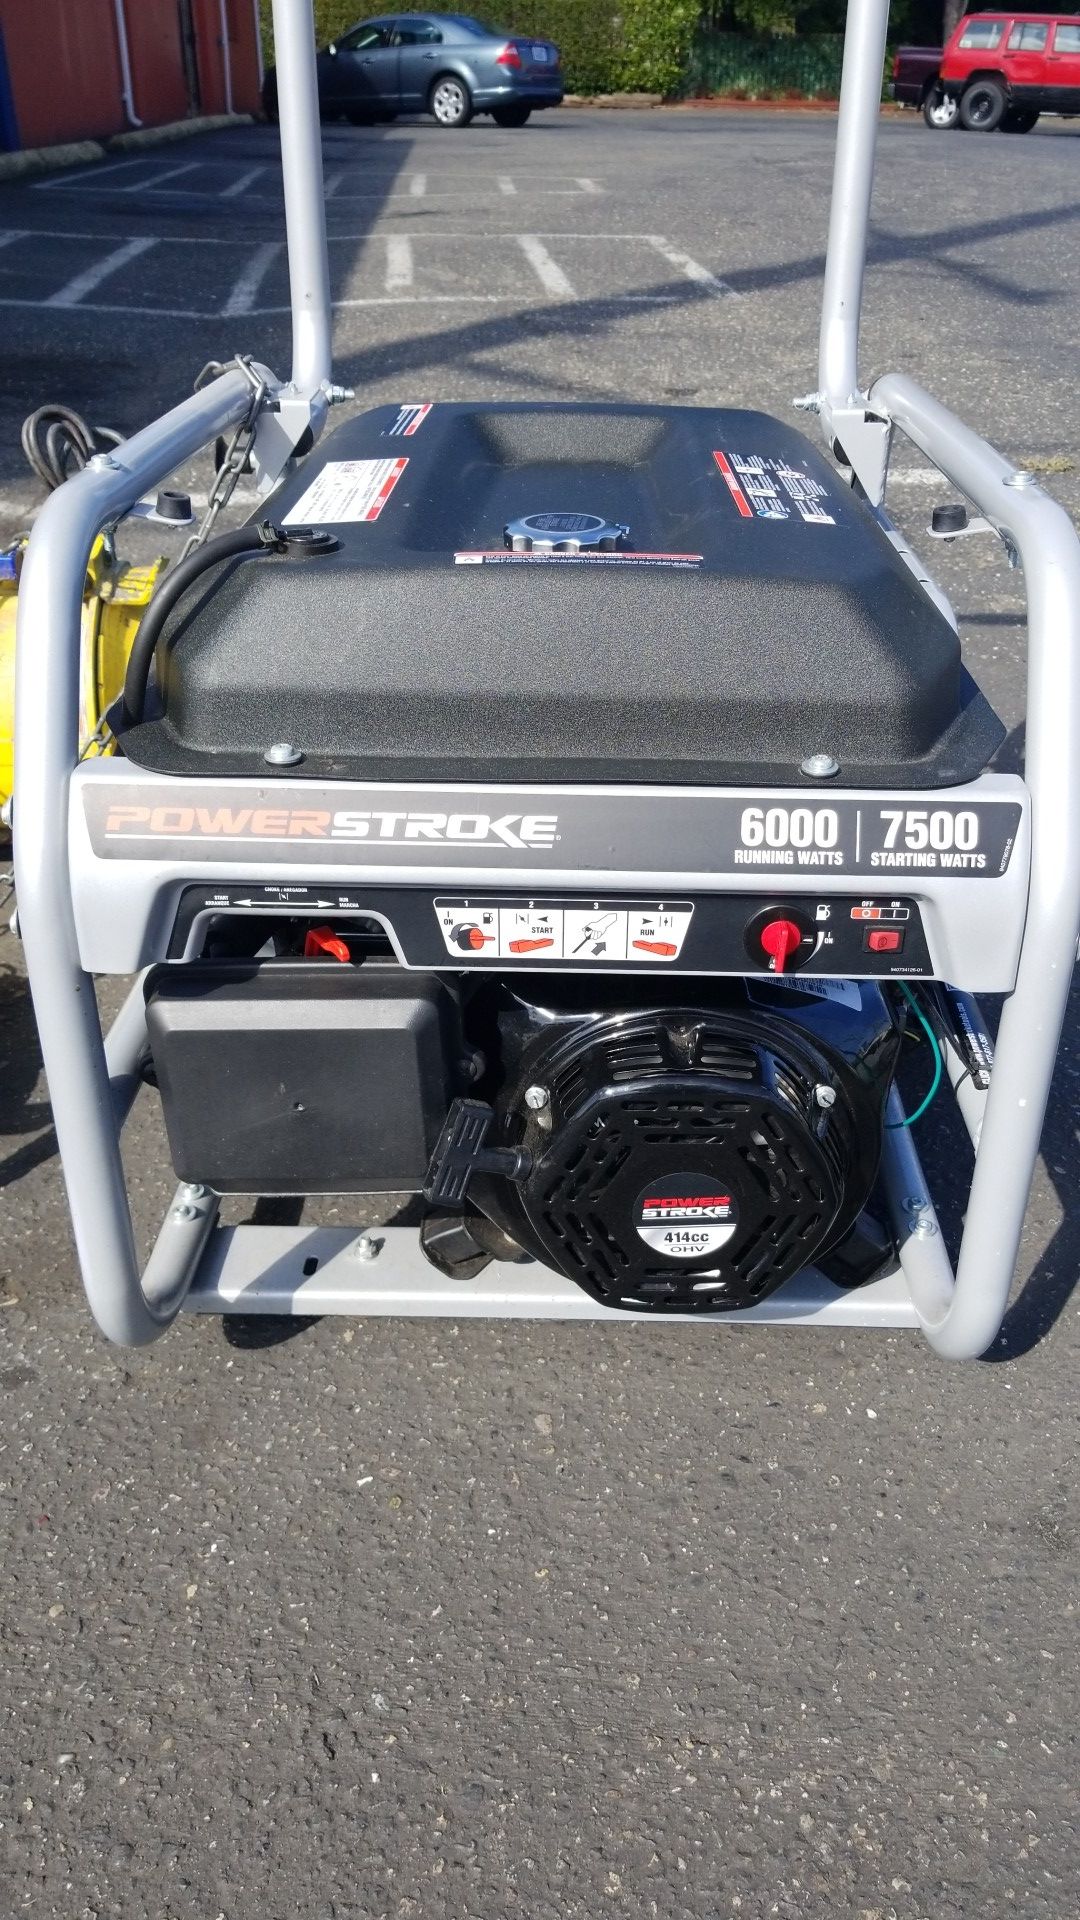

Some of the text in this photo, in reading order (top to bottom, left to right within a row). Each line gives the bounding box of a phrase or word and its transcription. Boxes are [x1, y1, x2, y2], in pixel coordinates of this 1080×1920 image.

[741, 808, 838, 847] 6000
[880, 811, 978, 850] 7500
[734, 850, 844, 865] RUNNING WATTS
[871, 852, 986, 868] STARTING WATTS
[593, 902, 599, 910] 3
[658, 903, 664, 911] 4
[443, 918, 454, 926] ON
[531, 926, 554, 934] START
[643, 1196, 731, 1208] POWER
[642, 1205, 730, 1218] STROKE
[664, 1231, 710, 1243] 414cc
[670, 1245, 705, 1253] OHV
